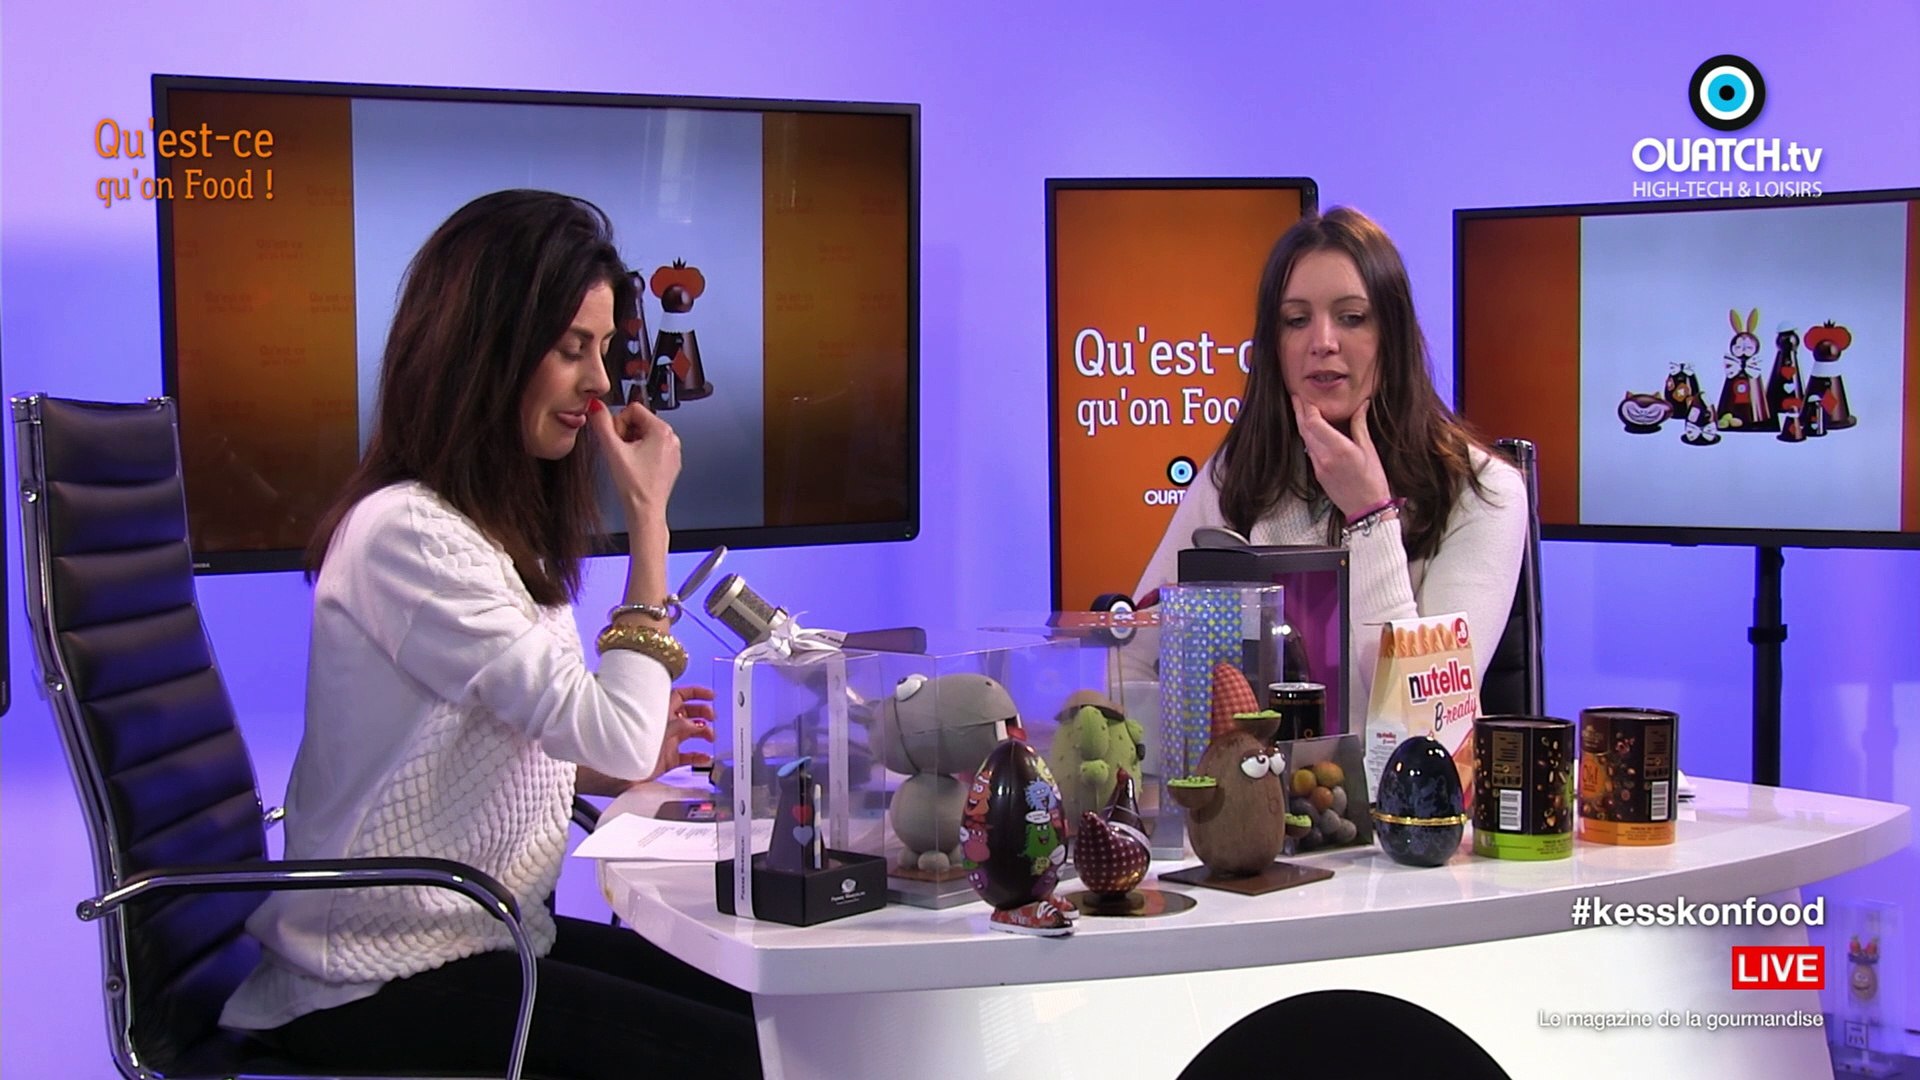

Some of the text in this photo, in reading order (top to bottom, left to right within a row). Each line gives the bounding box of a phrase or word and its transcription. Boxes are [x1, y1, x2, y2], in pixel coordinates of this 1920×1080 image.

[1074, 326, 1254, 377] Qu'est-c
[1077, 387, 1241, 436] qu'on Foo
[1144, 489, 1188, 505] OUAT
[1408, 660, 1473, 699] nutella
[1434, 692, 1477, 732] B-ready
